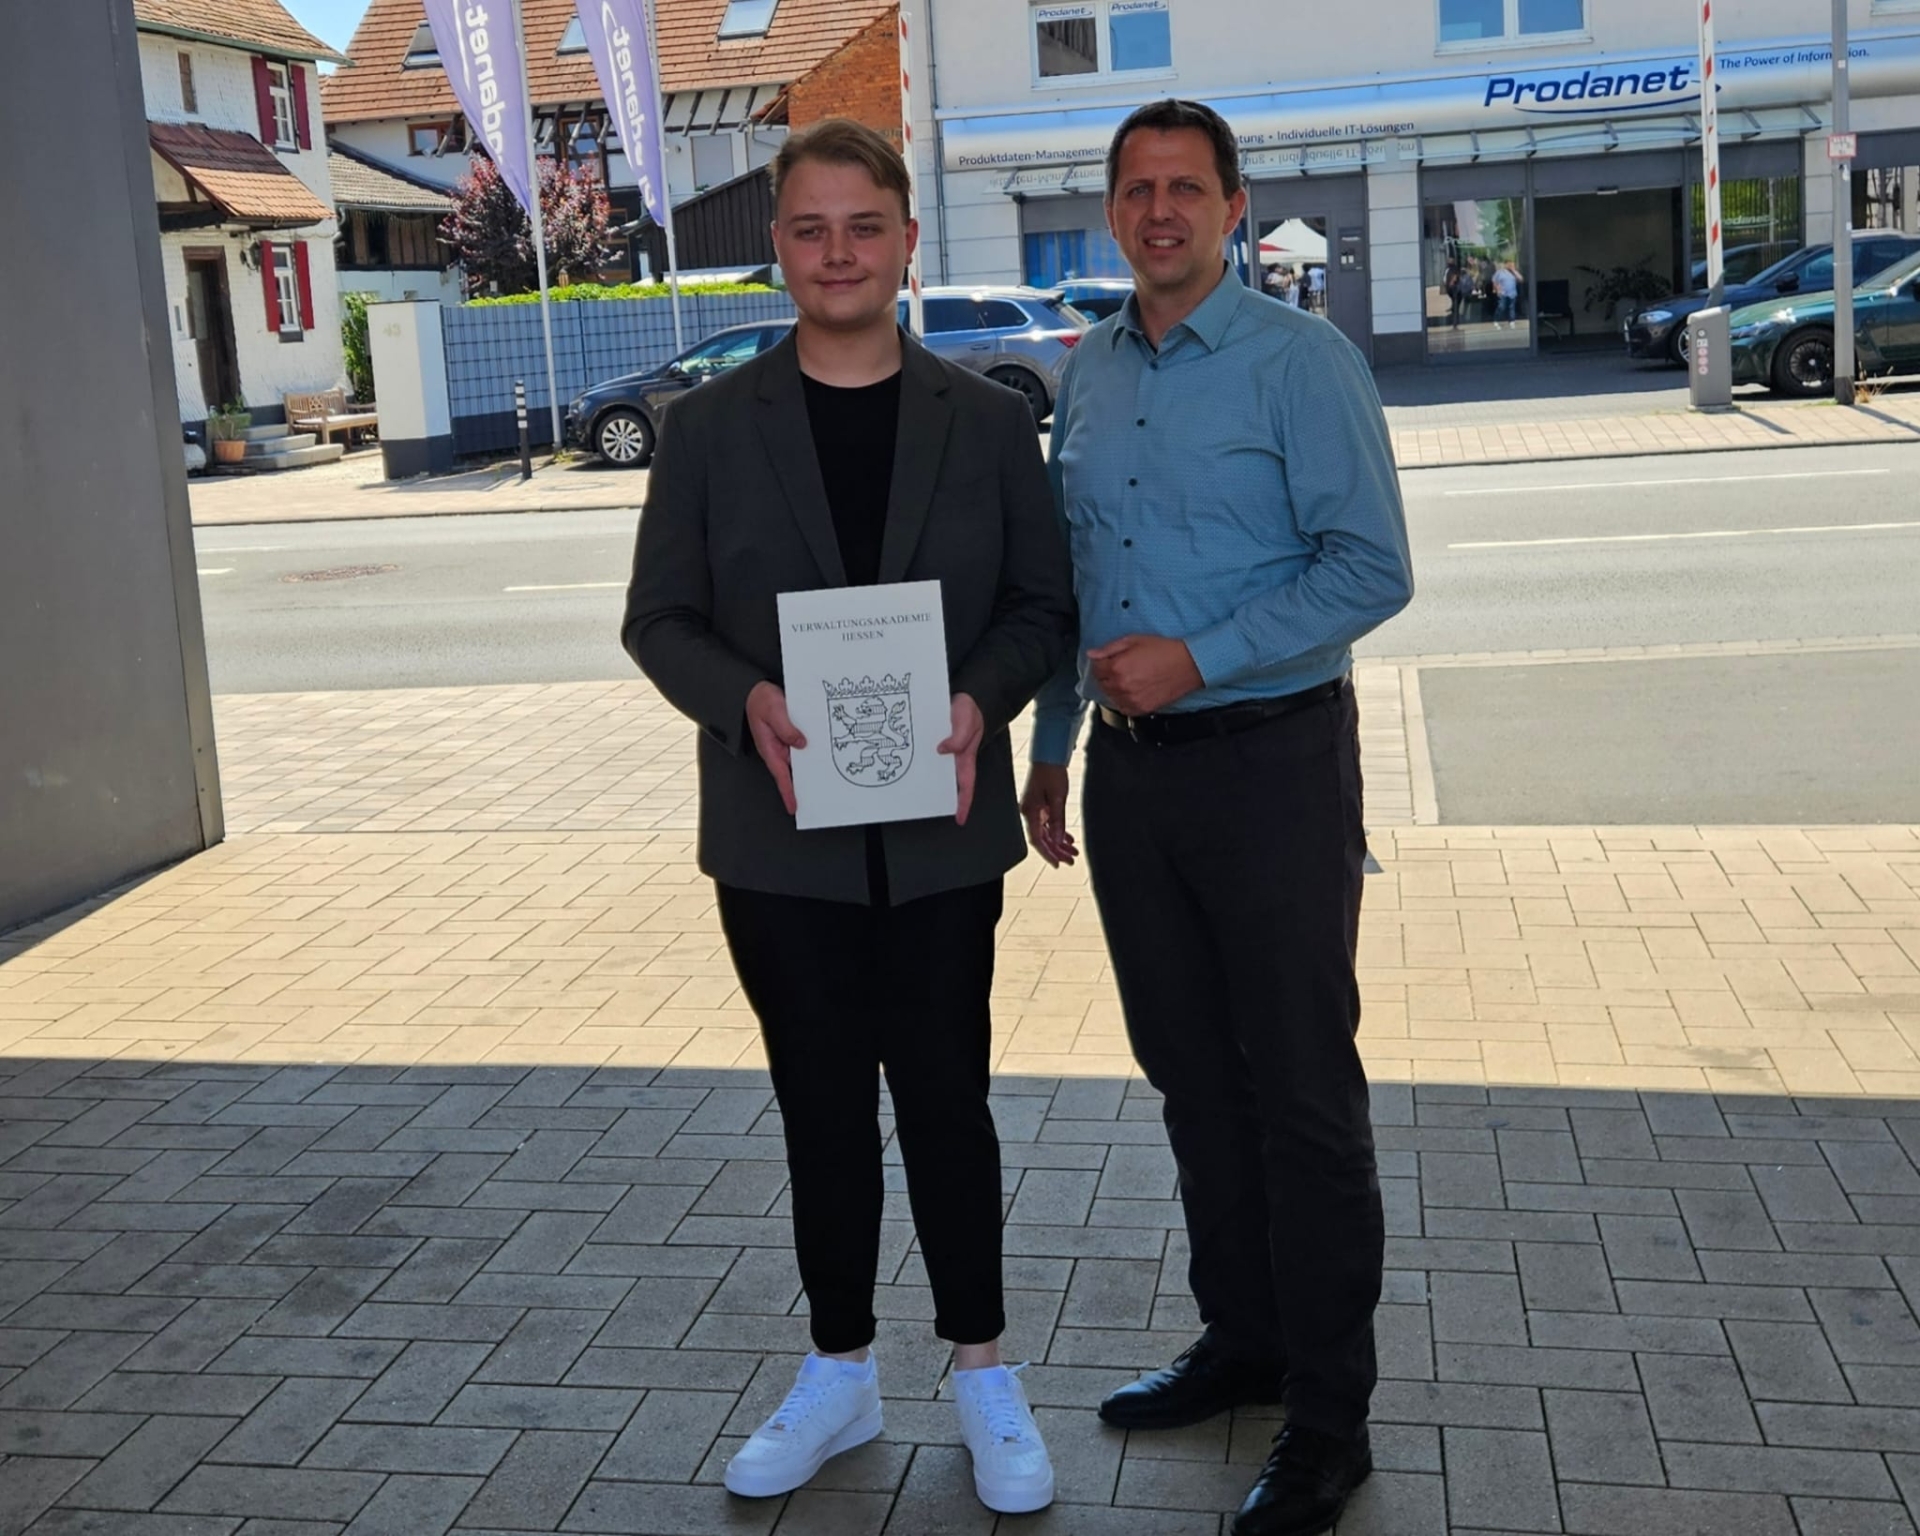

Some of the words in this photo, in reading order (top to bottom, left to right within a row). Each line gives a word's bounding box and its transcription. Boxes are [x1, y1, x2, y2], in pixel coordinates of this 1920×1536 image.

[1038, 7, 1085, 17] Prodanet
[1111, 1, 1158, 11] Prodanet
[1719, 58, 1741, 70] The
[1744, 56, 1780, 68] Power
[1783, 53, 1796, 64] of
[1484, 65, 1690, 107] Prodanet
[1277, 127, 1342, 141] Individuelle
[1344, 121, 1415, 135] IT-Lösungen
[791, 612, 931, 633] VERWALTUNGSAKADEMIE
[841, 630, 884, 641] HESSEN
